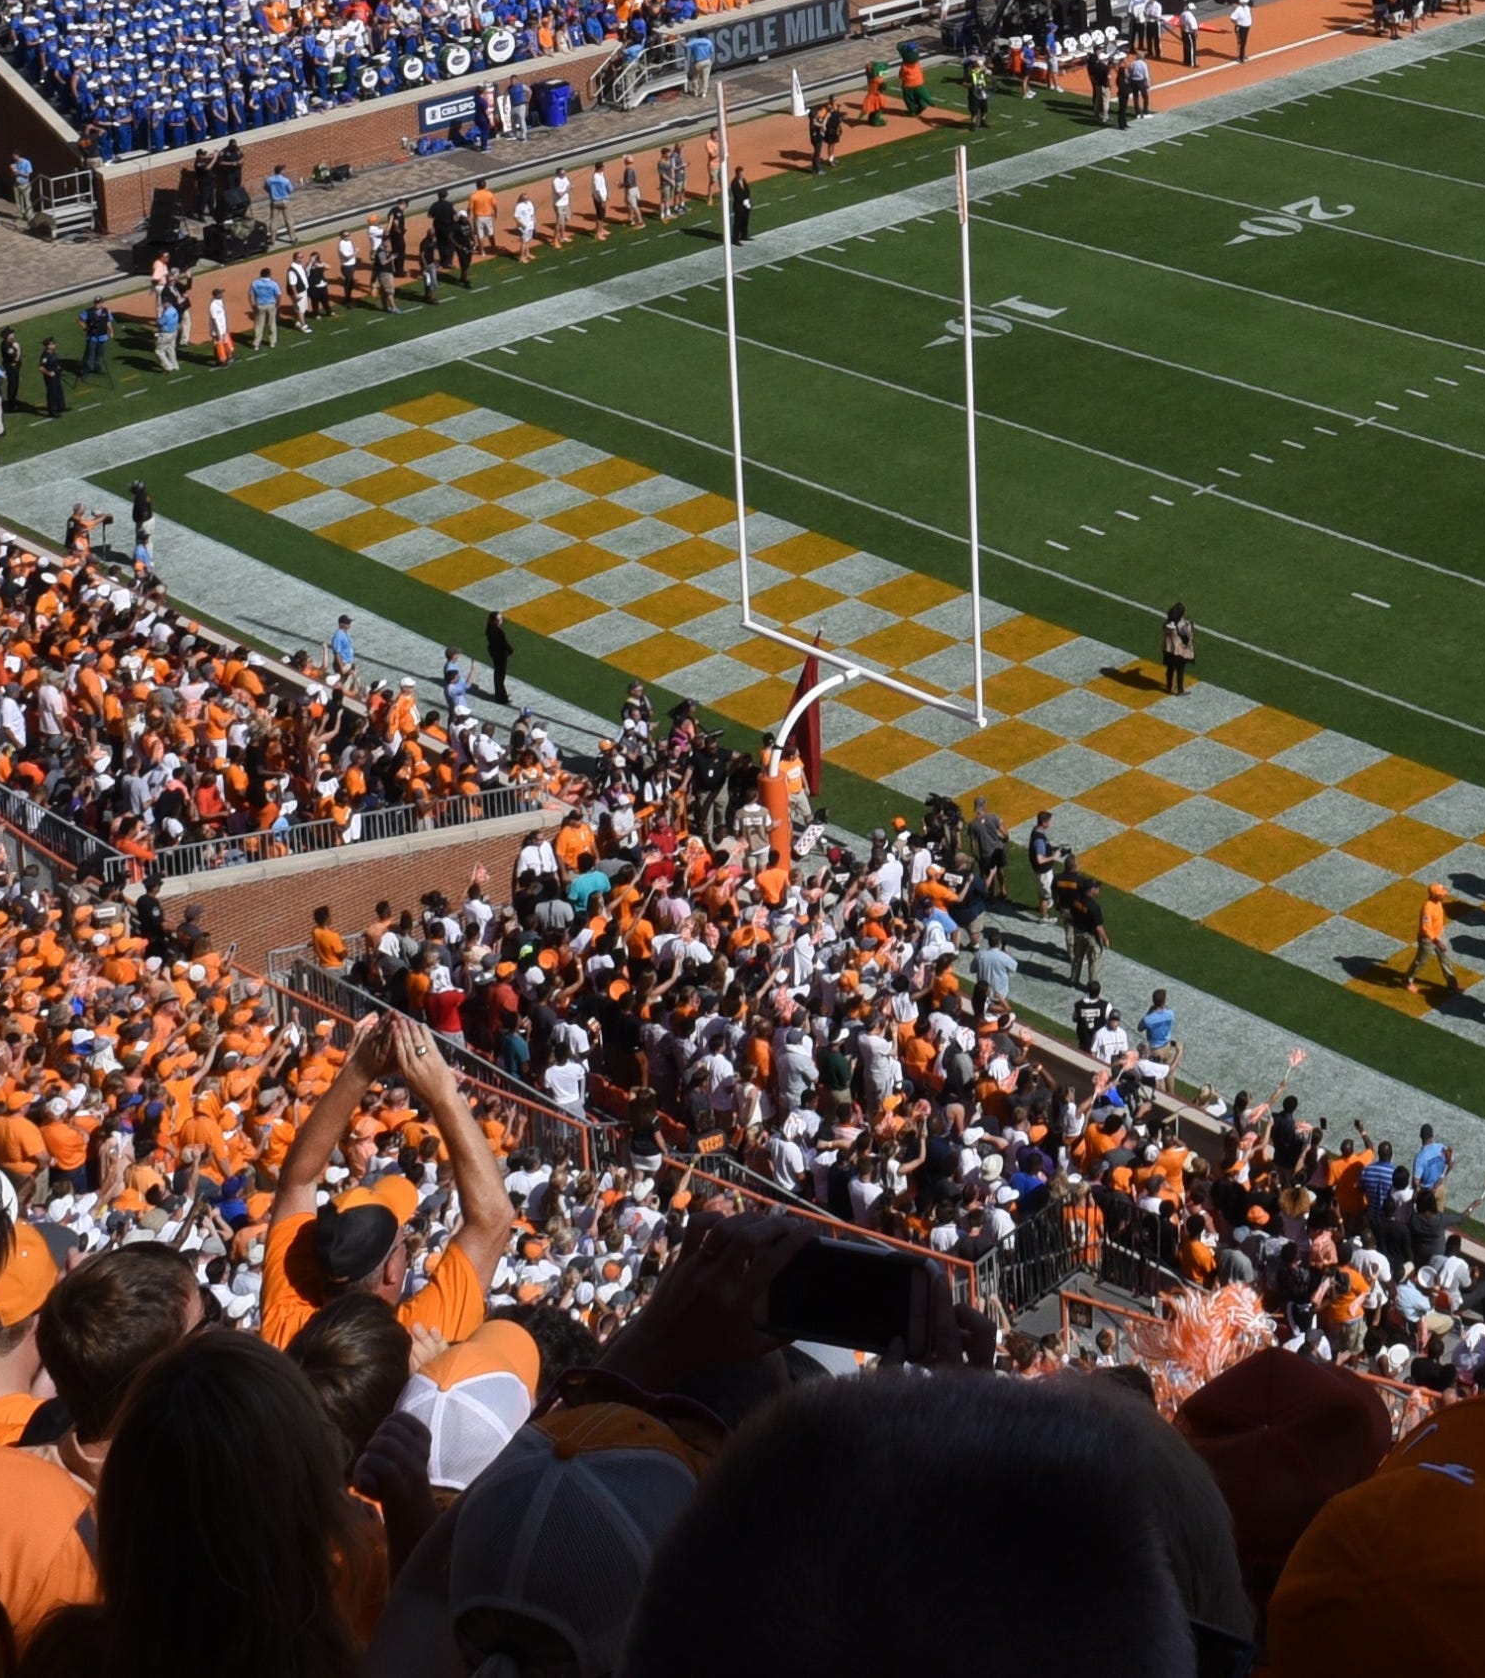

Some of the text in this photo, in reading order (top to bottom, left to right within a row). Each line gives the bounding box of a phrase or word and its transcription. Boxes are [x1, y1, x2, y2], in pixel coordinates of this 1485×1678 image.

[784, 0, 846, 47] MILK
[1239, 195, 1356, 236] 20
[945, 295, 1068, 339] 10
